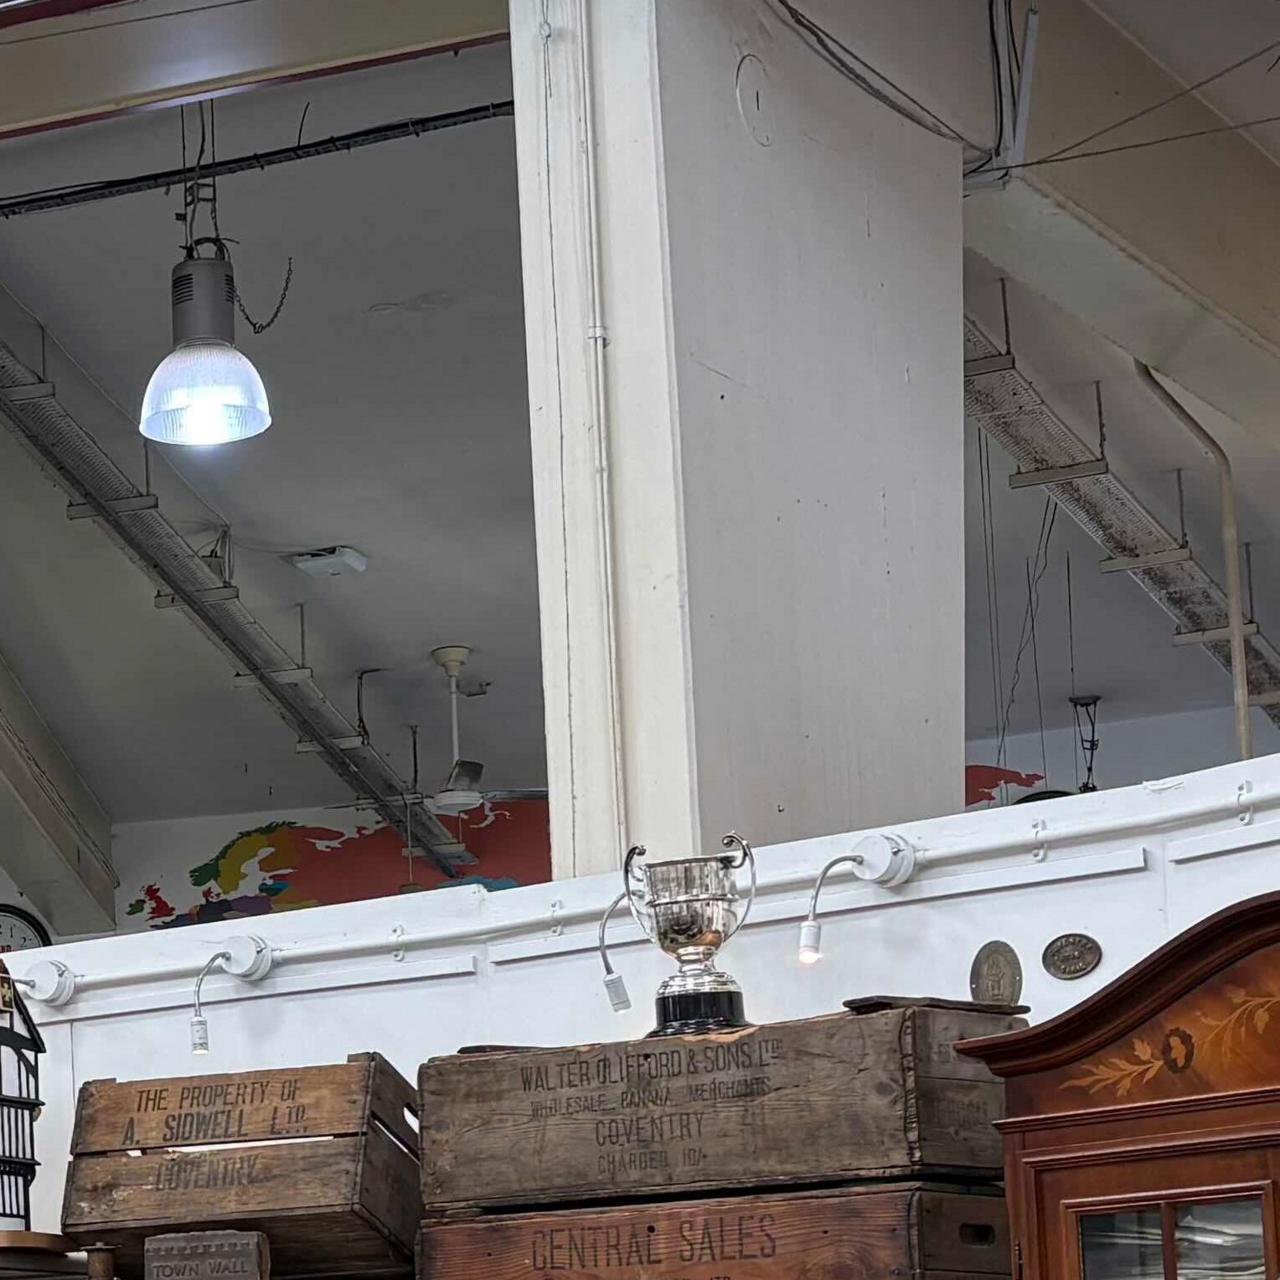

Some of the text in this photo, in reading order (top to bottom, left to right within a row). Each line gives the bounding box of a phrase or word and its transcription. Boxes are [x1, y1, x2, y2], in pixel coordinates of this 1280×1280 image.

[520, 1061, 590, 1092] WALTER
[703, 1042, 753, 1075] SONS
[135, 1079, 302, 1113] THE PROPERTY OF
[162, 1108, 249, 1144] SIDWELL
[595, 1112, 705, 1147] COVENTRY
[155, 1154, 260, 1192] COVENTRY
[531, 1213, 778, 1272] CENTRAL SALES
[152, 1258, 249, 1280] TOWN WALL
